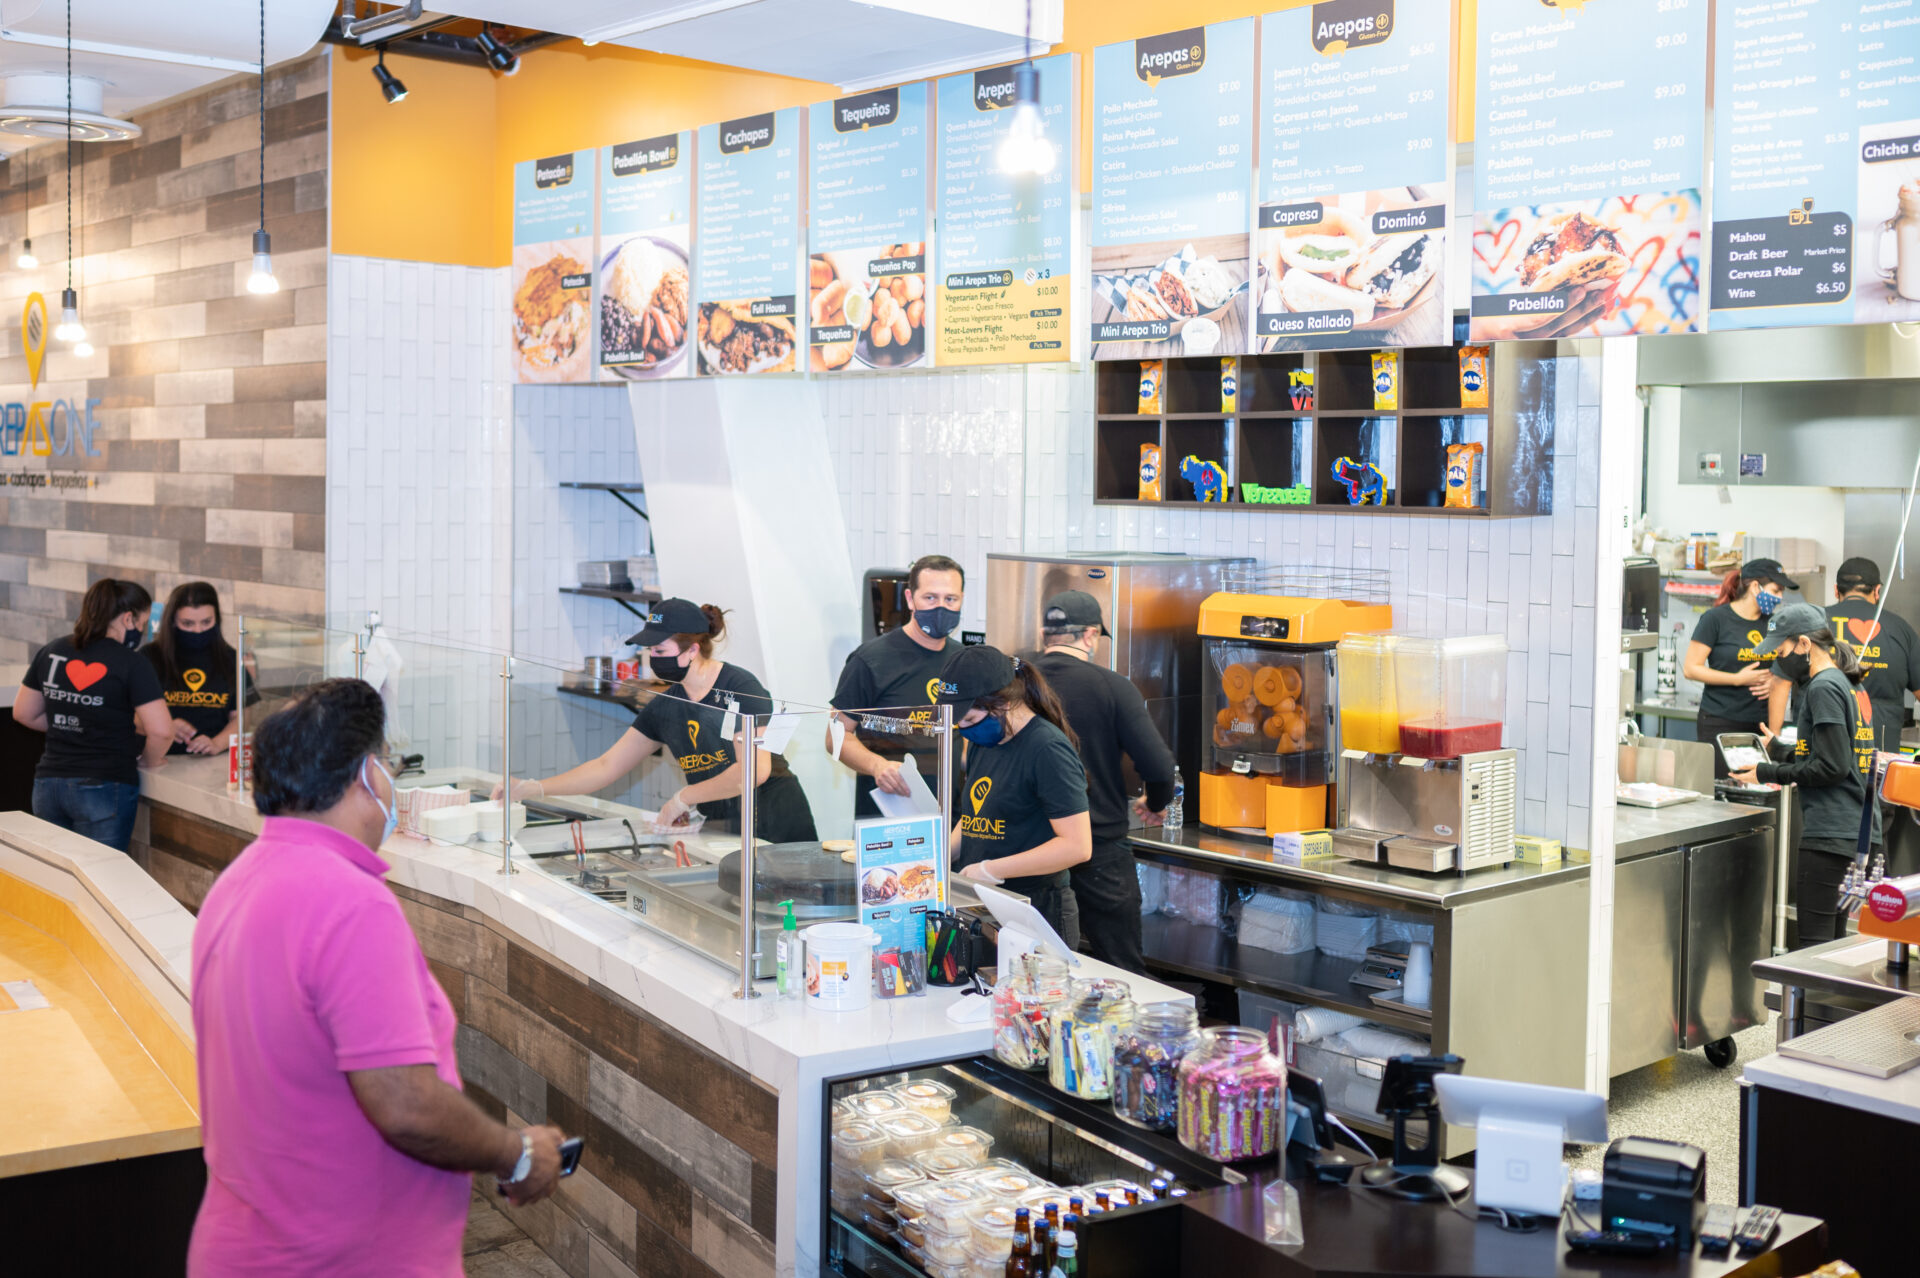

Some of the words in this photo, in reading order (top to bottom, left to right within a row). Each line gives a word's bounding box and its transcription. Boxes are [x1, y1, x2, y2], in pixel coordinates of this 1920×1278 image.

[1317, 16, 1374, 39] Arepas
[1358, 30, 1389, 40] Gluten-Free
[1525, 20, 1576, 36] Mechada
[1490, 42, 1534, 58] Shredded
[1536, 36, 1560, 50] Beef
[1656, 32, 1688, 48] $9.00
[1858, 42, 1885, 52] Latte
[1140, 48, 1189, 69] Arepas
[1857, 56, 1914, 71] Cappuccino
[1274, 66, 1303, 81] Jamón
[1311, 62, 1342, 74] Queso
[1274, 82, 1292, 92] Ham
[1303, 73, 1341, 87] Shredded
[1342, 71, 1369, 82] Queso
[1370, 66, 1399, 78] Fresco
[1218, 81, 1241, 94] $7.00
[1489, 74, 1532, 91] Shredded
[1534, 70, 1556, 83] Beef
[1857, 77, 1897, 90] Caramel
[1274, 94, 1310, 107] Shredded
[1311, 89, 1345, 101] Cheddar
[1347, 85, 1377, 96] Cheese
[1407, 89, 1435, 104] $7.50
[1500, 90, 1544, 105] Shredded
[1546, 84, 1586, 99] Cheddar
[1588, 79, 1625, 93] Cheese
[1654, 83, 1686, 99] $9.00
[1103, 103, 1122, 114] Pollo
[1123, 98, 1159, 111] Mechado
[1856, 98, 1889, 110] Mocha
[841, 103, 891, 123] Tequeños
[1273, 111, 1309, 124] Capresa
[1311, 108, 1328, 119] con
[1329, 104, 1359, 118] Jamón
[1273, 127, 1302, 136] Tomato
[1343, 117, 1370, 128] Queso
[1372, 114, 1383, 124] de
[1384, 111, 1409, 121] Mano
[1489, 121, 1533, 136] Shredded
[1535, 117, 1558, 130] Beef
[725, 128, 769, 146] Cachapas
[1102, 132, 1123, 142] Reina
[1160, 136, 1179, 146] Salad
[1282, 139, 1300, 150] Basil
[1407, 137, 1433, 152] $9.00
[1500, 136, 1545, 151] Shredded
[1546, 133, 1579, 146] Queso
[1580, 128, 1614, 142] Fresco
[1653, 135, 1685, 151] $9.00
[613, 149, 648, 169] Pabellón
[649, 146, 669, 163] Bowl
[1864, 142, 1909, 158] Chicha
[1102, 160, 1126, 171] Catira
[1171, 162, 1204, 176] Shredded
[1205, 159, 1237, 171] Cheddar
[1272, 156, 1298, 168] Pernil
[1487, 156, 1534, 171] Pabellón
[537, 164, 566, 181] Patacón
[1272, 171, 1302, 182] Roasted
[1303, 168, 1323, 178] Pork
[1333, 164, 1365, 175] Tomato
[1487, 170, 1532, 185] Shredded
[1533, 167, 1556, 179] Beef
[1569, 160, 1616, 176] Shredded
[1618, 157, 1653, 171] Queso
[1281, 186, 1307, 196] Queso
[1308, 183, 1335, 193] Fresco
[1487, 189, 1519, 201] Fresco
[1532, 185, 1561, 197] Sweet
[1563, 180, 1606, 193] Plantains
[1621, 175, 1648, 187] Black
[1650, 171, 1681, 184] Beans
[1216, 191, 1239, 203] $9.00
[1273, 208, 1319, 226] Capresa
[1378, 211, 1427, 230] Dominó
[1729, 231, 1766, 243] Mahou
[1833, 223, 1847, 236] $5
[1729, 250, 1758, 262] Draft
[1761, 248, 1788, 260] Beer
[1804, 248, 1828, 256] Market
[1829, 247, 1846, 255] Price
[870, 262, 901, 274] Tequeños
[902, 260, 916, 272] Pop
[1729, 268, 1772, 281] Cerveza
[1774, 265, 1803, 277] Polar
[1832, 262, 1846, 274] $6
[948, 276, 964, 287] Mini
[965, 275, 987, 287] Arepa
[988, 273, 1001, 284] Trio
[1037, 271, 1043, 279] x
[1045, 269, 1050, 279] 3
[1037, 286, 1059, 297] $10.00
[1728, 287, 1756, 299] Wine
[1816, 282, 1846, 295] $6.50
[945, 293, 978, 303] Vegetarian
[979, 290, 998, 302] Flight
[1508, 295, 1564, 312] Pabellón
[751, 302, 765, 315] Full
[766, 301, 787, 313] House
[976, 302, 994, 312] Queso
[995, 301, 1014, 310] Fresco
[1008, 312, 1029, 322] Vegana
[1269, 316, 1304, 332] Queso
[1307, 314, 1351, 330] Rallado
[944, 325, 983, 335] Meat-Lovers
[984, 323, 1003, 335] Flight
[1037, 320, 1058, 331] $10.00
[1100, 325, 1118, 338] Mini
[1119, 324, 1149, 338] Arepa
[1150, 323, 1168, 335] Trio
[818, 329, 851, 341] Tequeños
[1010, 331, 1037, 341] Mechado
[604, 352, 628, 363] Pabellón
[629, 350, 644, 361] Bowl
[1241, 483, 1312, 504] Venezuela
[966, 635, 983, 643] HAND
[43, 653, 68, 689] I
[42, 687, 104, 706] PEPITOS
[961, 814, 1006, 835] EPASONE
[1872, 891, 1903, 906] Mahou
